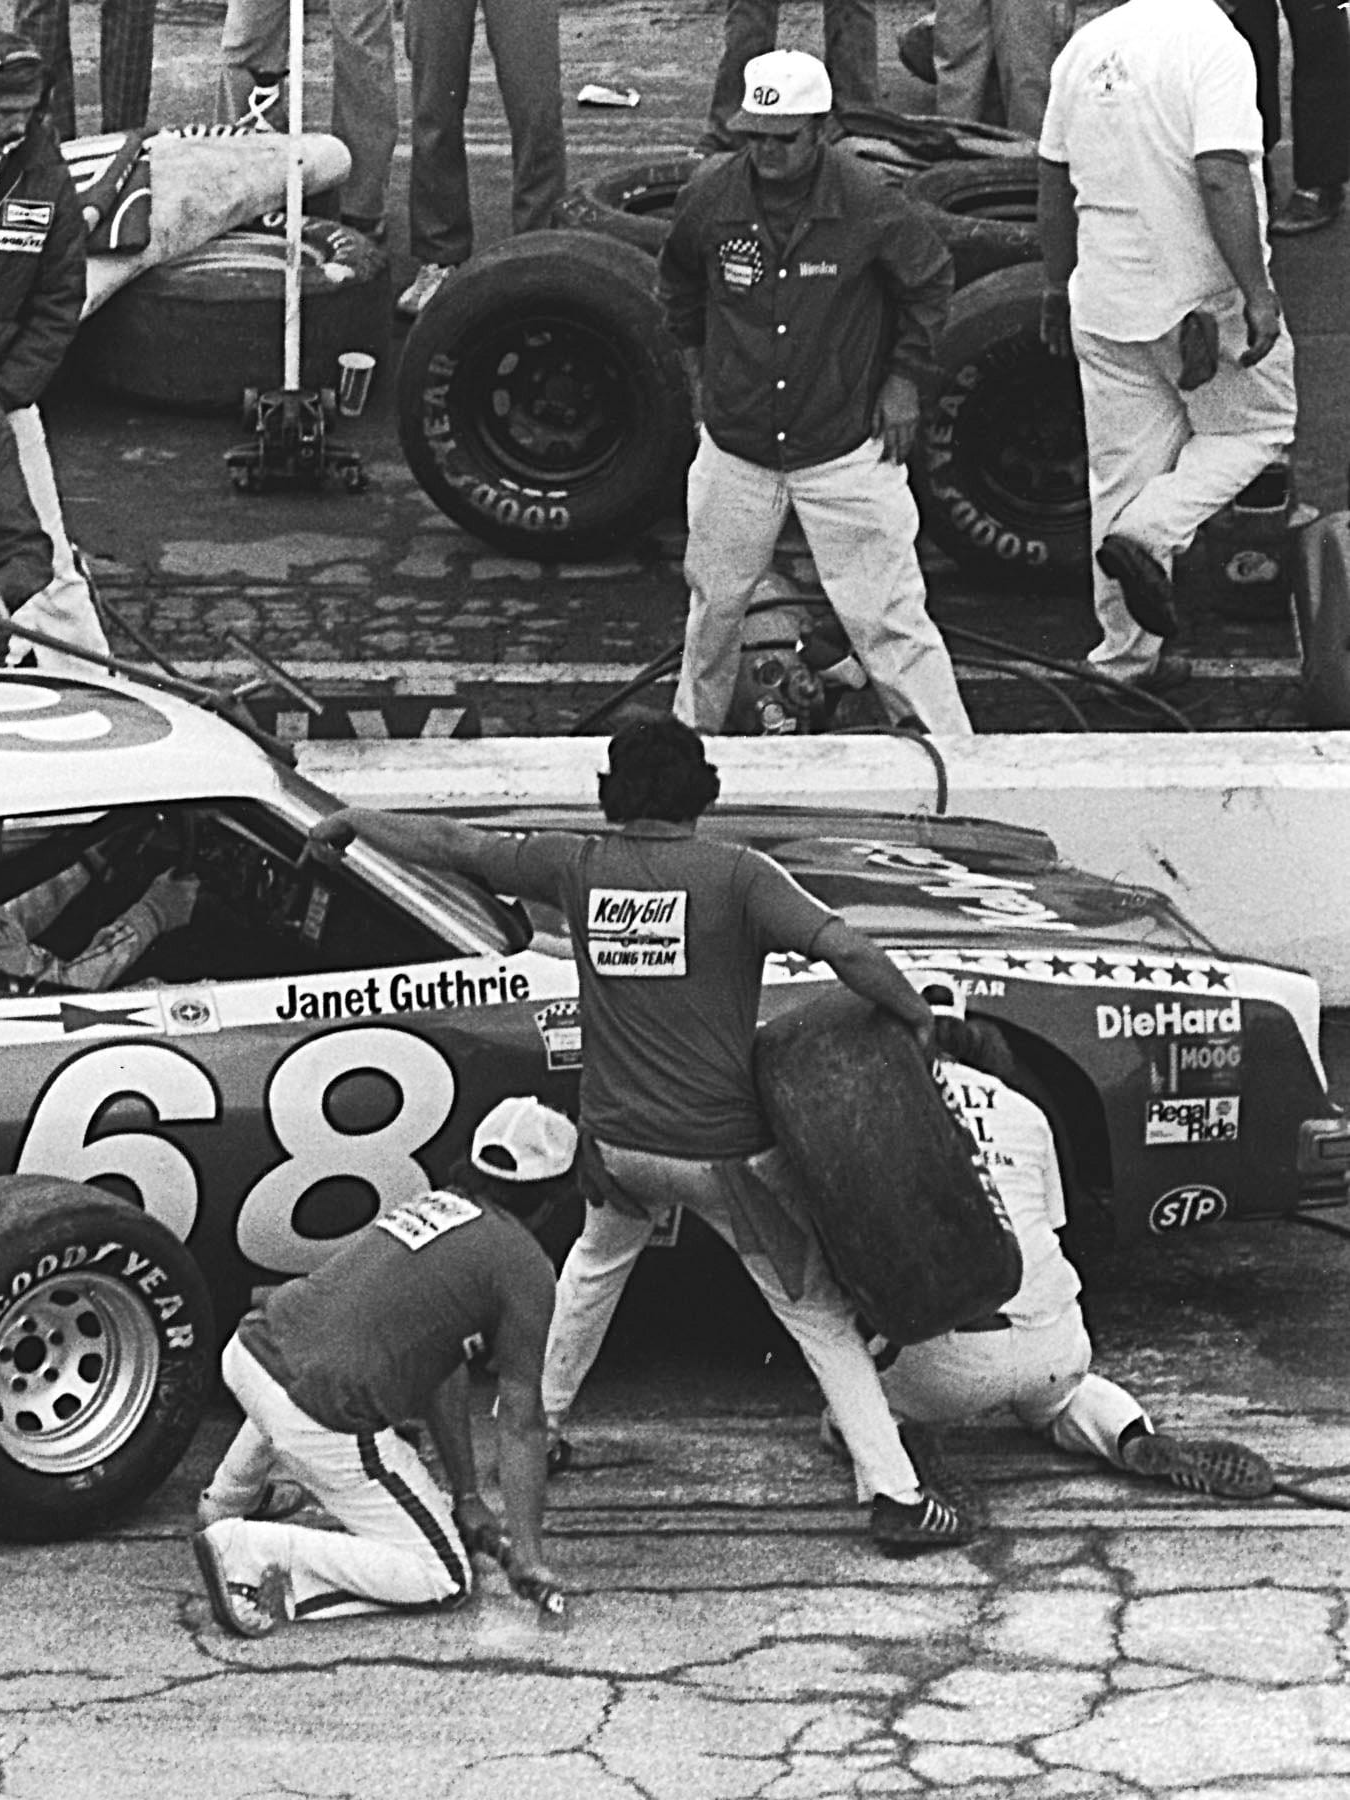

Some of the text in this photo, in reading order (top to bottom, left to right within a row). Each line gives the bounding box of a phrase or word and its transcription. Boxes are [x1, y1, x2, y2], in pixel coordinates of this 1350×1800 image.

[594, 897, 678, 931] Kelly Girl
[597, 951, 677, 966] RACING TEAM
[276, 965, 531, 1020] Janet Guthrie
[956, 978, 1006, 998] EAR
[1096, 998, 1242, 1039] DieHard
[1181, 1045, 1242, 1070] MOOG
[1149, 1100, 1211, 1127] Regal
[1187, 1118, 1237, 1142] Ride
[14, 1023, 456, 1275] 68
[1160, 1191, 1216, 1227] STP
